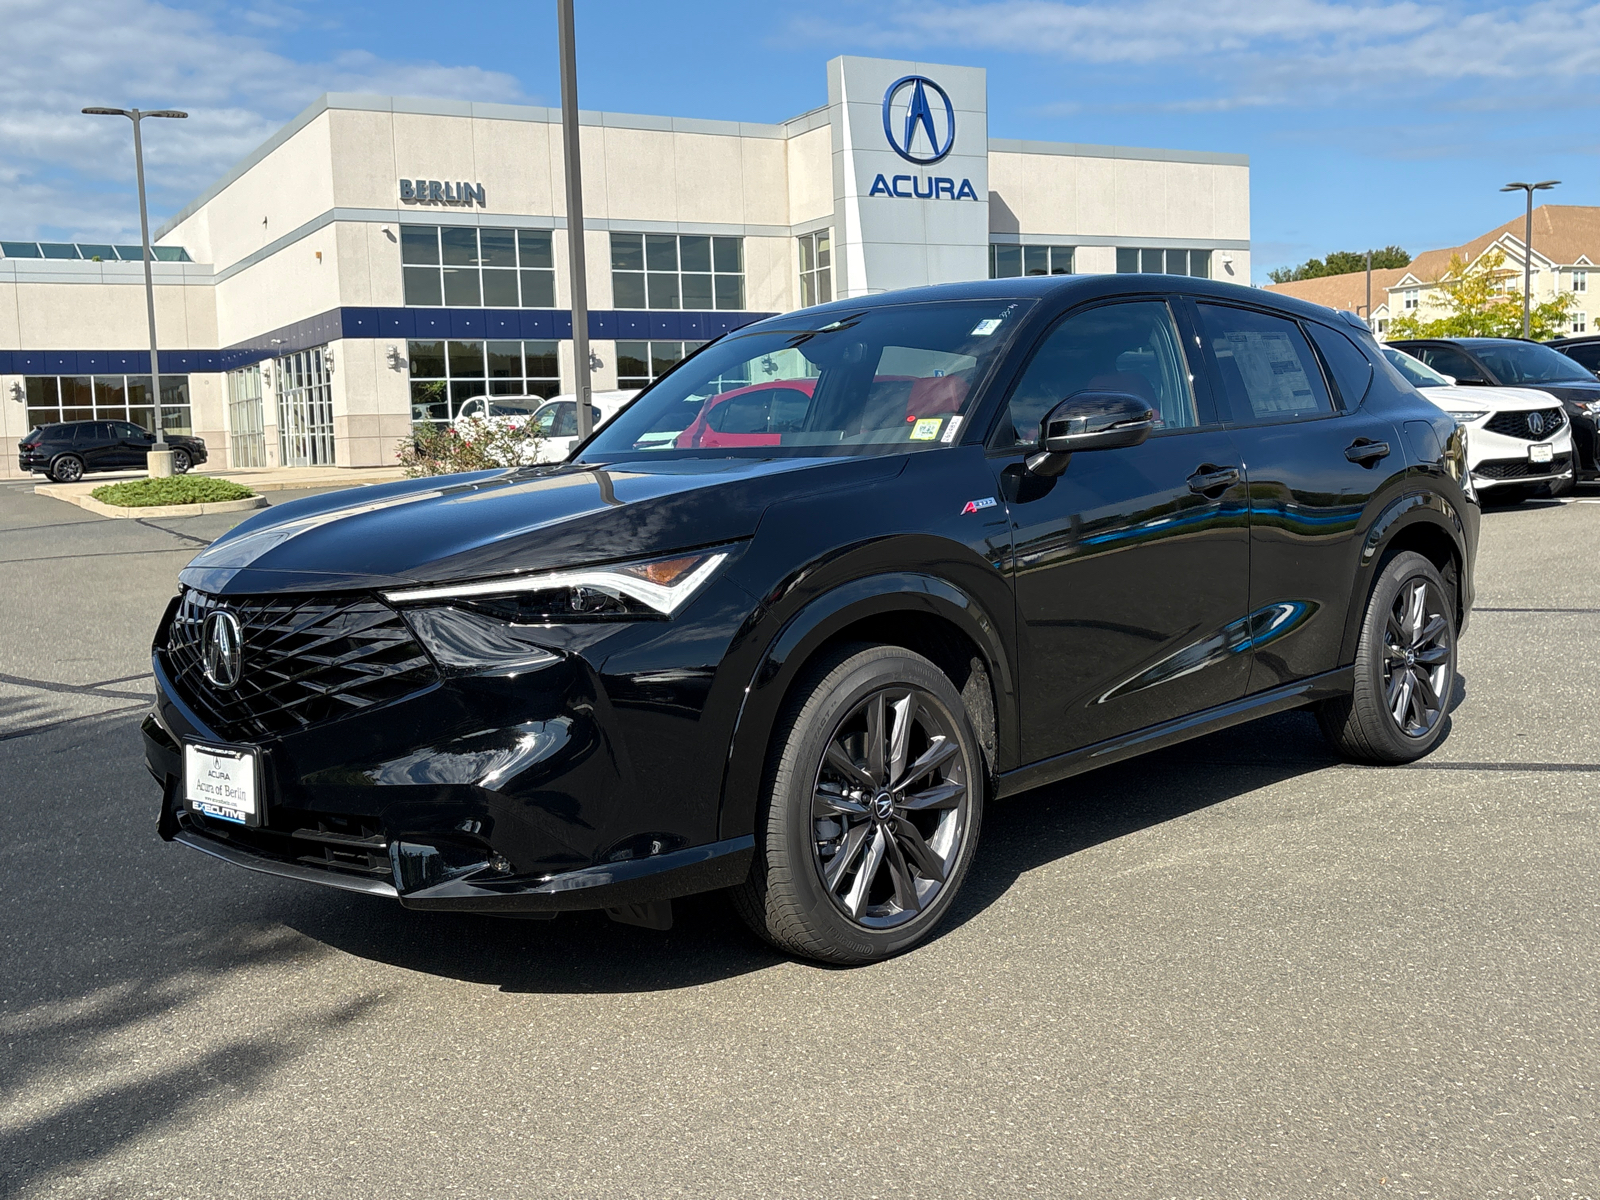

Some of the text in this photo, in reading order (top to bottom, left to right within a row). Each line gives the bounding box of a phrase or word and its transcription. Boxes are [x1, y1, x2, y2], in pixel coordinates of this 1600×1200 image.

[399, 178, 486, 206] BERLIN
[868, 173, 979, 201] ACURA
[208, 769, 231, 781] ACURA
[196, 778, 215, 794] Acura
[215, 784, 223, 796] of
[224, 784, 246, 802] Berlin
[192, 800, 246, 821] EXECUTIVE
